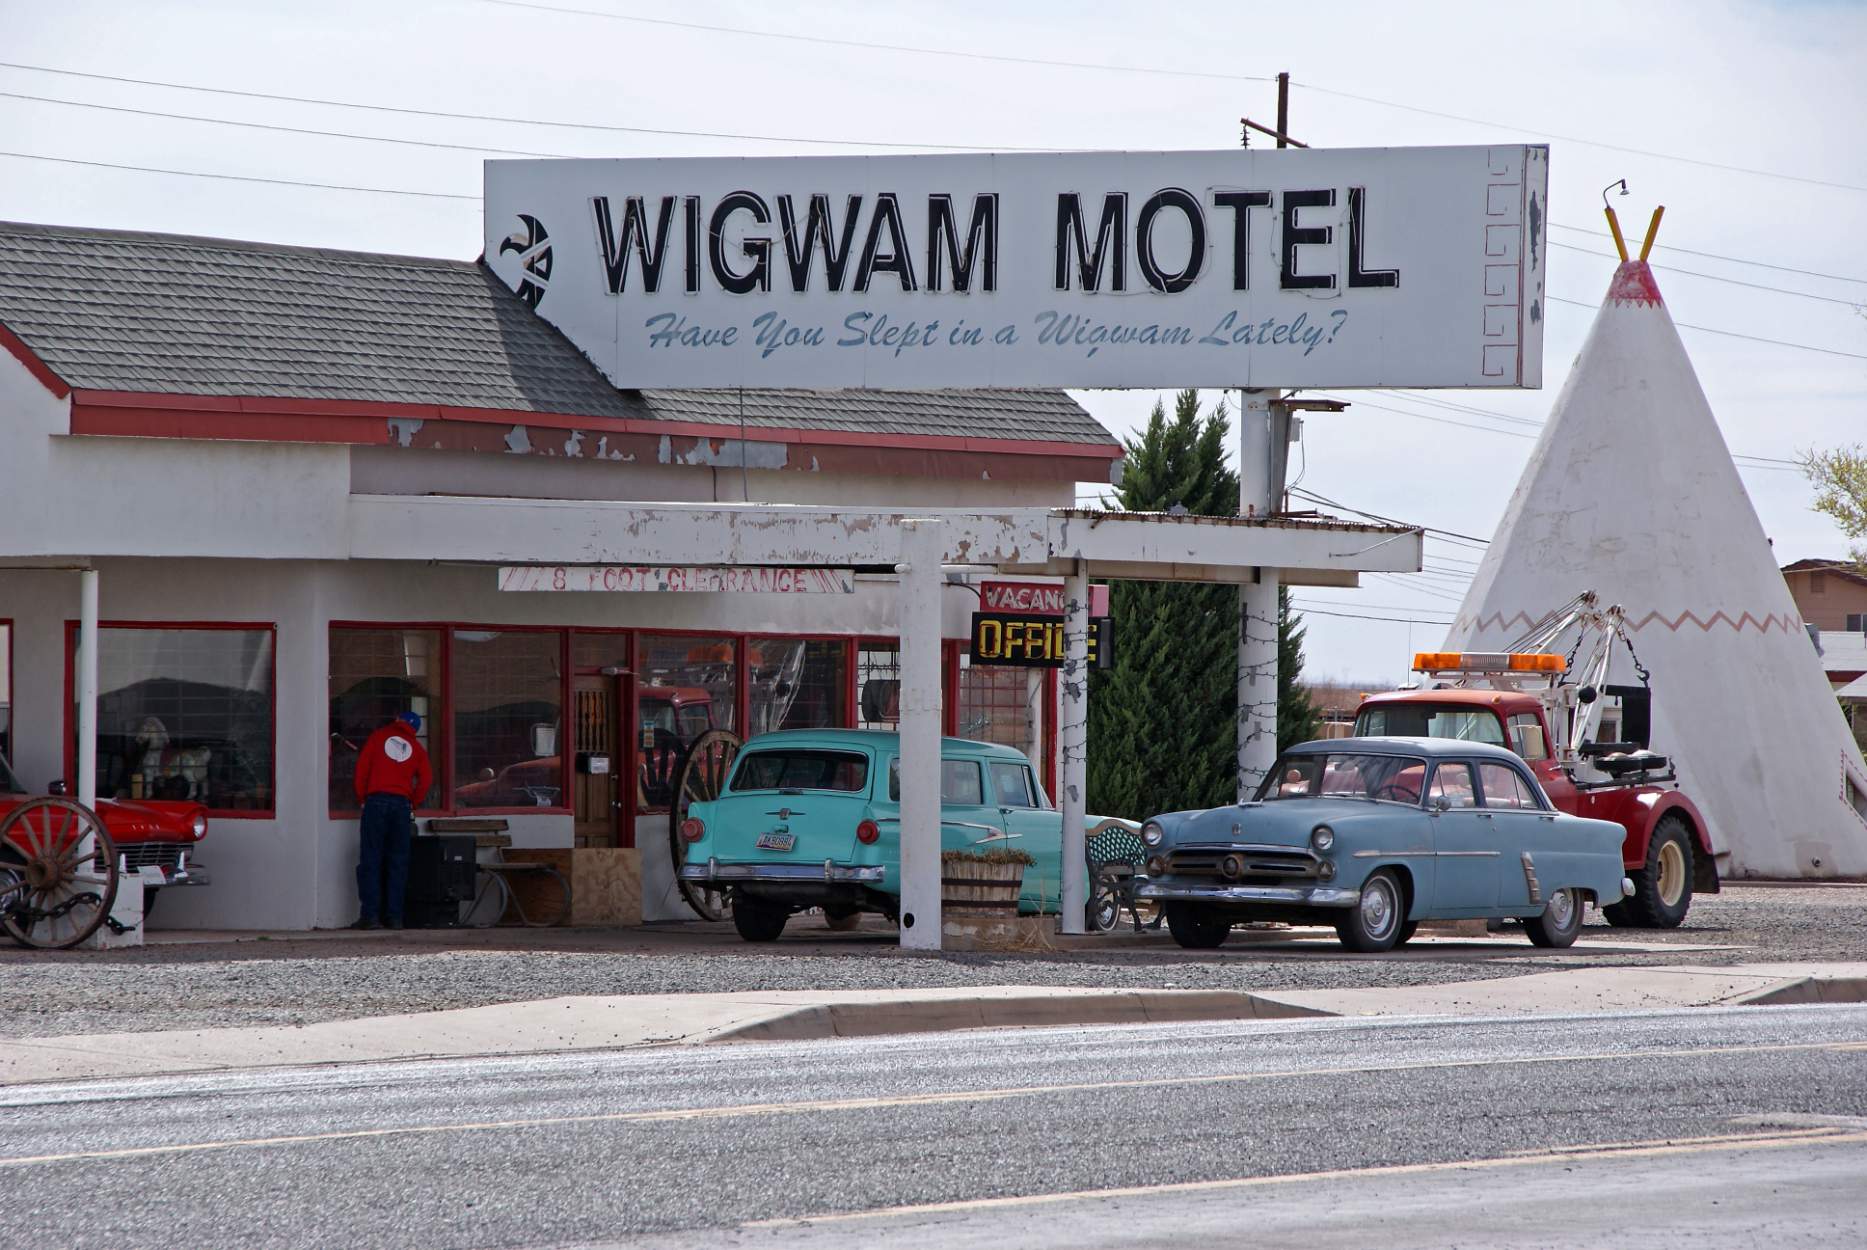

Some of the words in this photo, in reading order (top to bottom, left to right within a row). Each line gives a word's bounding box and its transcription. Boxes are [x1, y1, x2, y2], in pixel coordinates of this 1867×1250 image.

[589, 190, 1000, 296] WIGWAM
[1054, 186, 1400, 295] MOTEL
[645, 312, 738, 349] Have
[752, 311, 824, 359] You
[837, 311, 938, 358] Slept
[949, 316, 985, 344] in
[995, 322, 1020, 345] a
[1034, 311, 1192, 357] Wigwam
[1198, 309, 1348, 357] Lately?
[553, 567, 566, 590] 8
[667, 567, 807, 592] CLEARANCE
[985, 586, 1064, 610] VACAN
